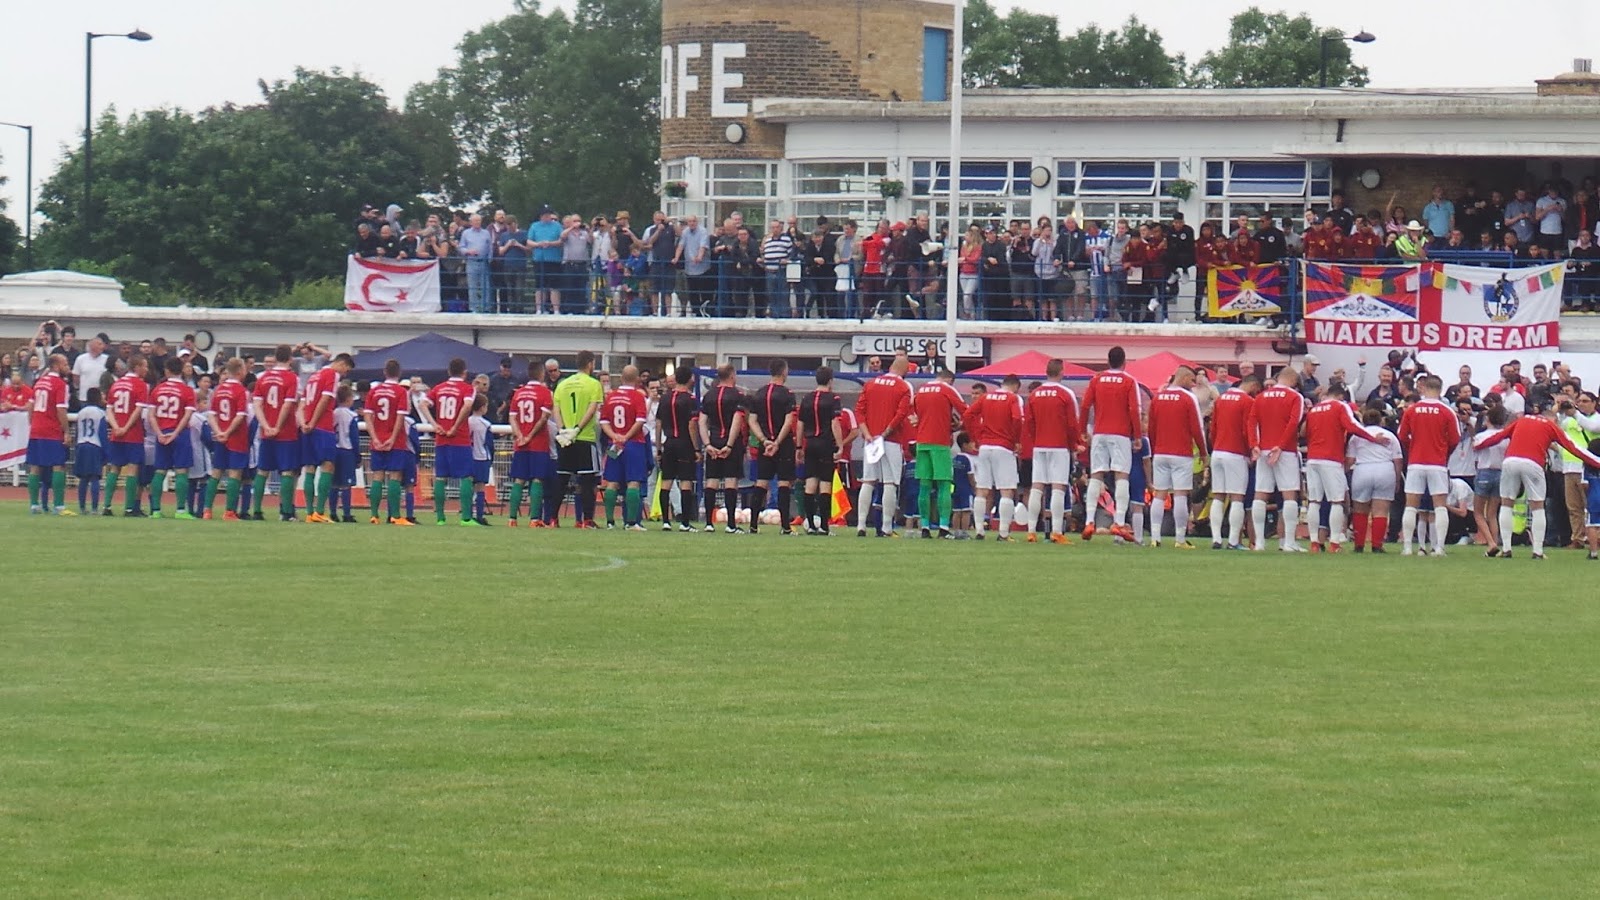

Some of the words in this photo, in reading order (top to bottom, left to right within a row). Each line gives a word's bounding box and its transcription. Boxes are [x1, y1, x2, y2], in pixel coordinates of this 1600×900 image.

[874, 338, 914, 352] CLUB
[918, 338, 962, 353] SOP
[1314, 322, 1393, 344] MAKE
[1402, 323, 1440, 345] US
[1448, 325, 1548, 349] DREAM
[34, 389, 49, 412] 10
[114, 389, 130, 413] 21
[156, 395, 180, 419] 22
[266, 386, 279, 408] 4
[439, 396, 457, 419] 18
[570, 391, 576, 413] 1
[219, 400, 231, 421] 9
[377, 398, 390, 420] 3
[517, 400, 534, 423] 13
[613, 406, 626, 428] 8
[81, 418, 95, 437] 13
